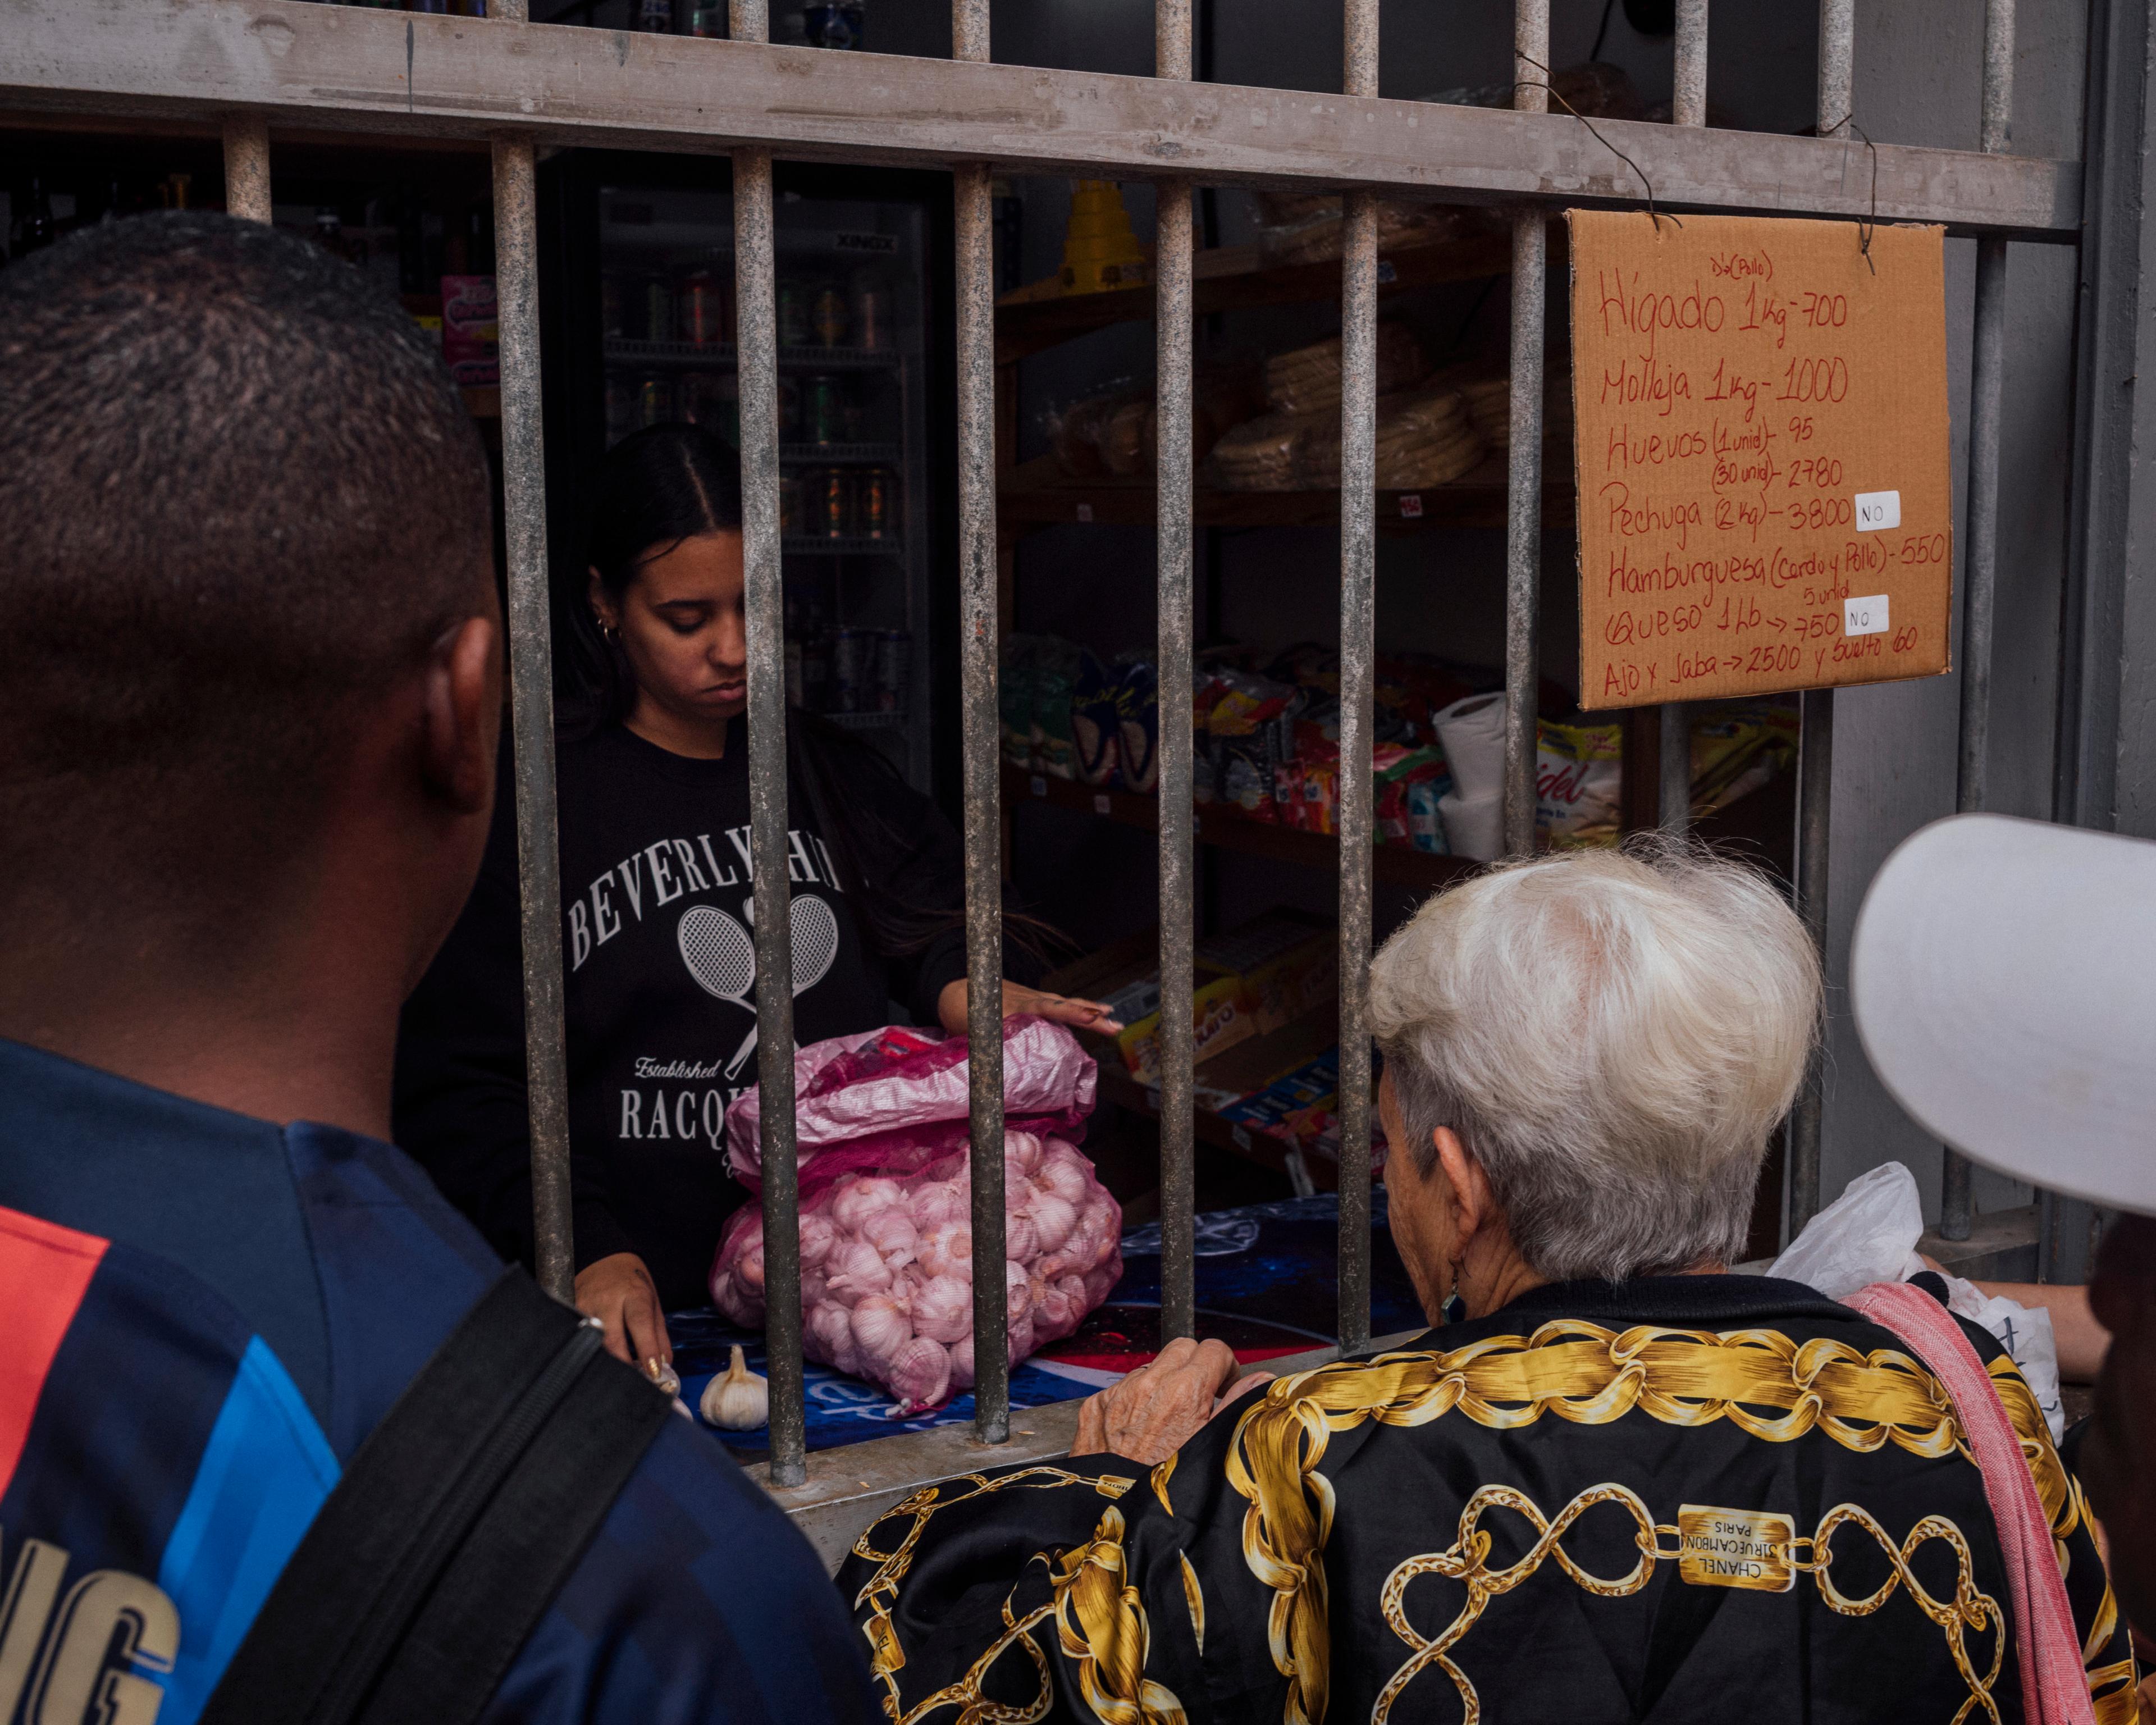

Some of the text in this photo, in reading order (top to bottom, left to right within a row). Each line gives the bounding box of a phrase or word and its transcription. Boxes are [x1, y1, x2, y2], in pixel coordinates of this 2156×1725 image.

[1601, 359, 1692, 417] Molleja
[1607, 423, 1706, 472] Huevos
[1788, 416, 1814, 444] 95
[1788, 457, 1842, 489] 2780
[1787, 498, 1852, 530] 3800
[1861, 505, 1884, 522] NO
[1608, 546, 1766, 608] Hamburguesa
[1900, 533, 1945, 564] 550
[1793, 612, 1840, 642] 750
[1849, 611, 1870, 627] NO
[1746, 646, 1801, 673] 2500
[1892, 626, 1918, 654] 60
[1715, 1522, 1751, 1537] PARIS
[1698, 1558, 1761, 1579] CHANEL
